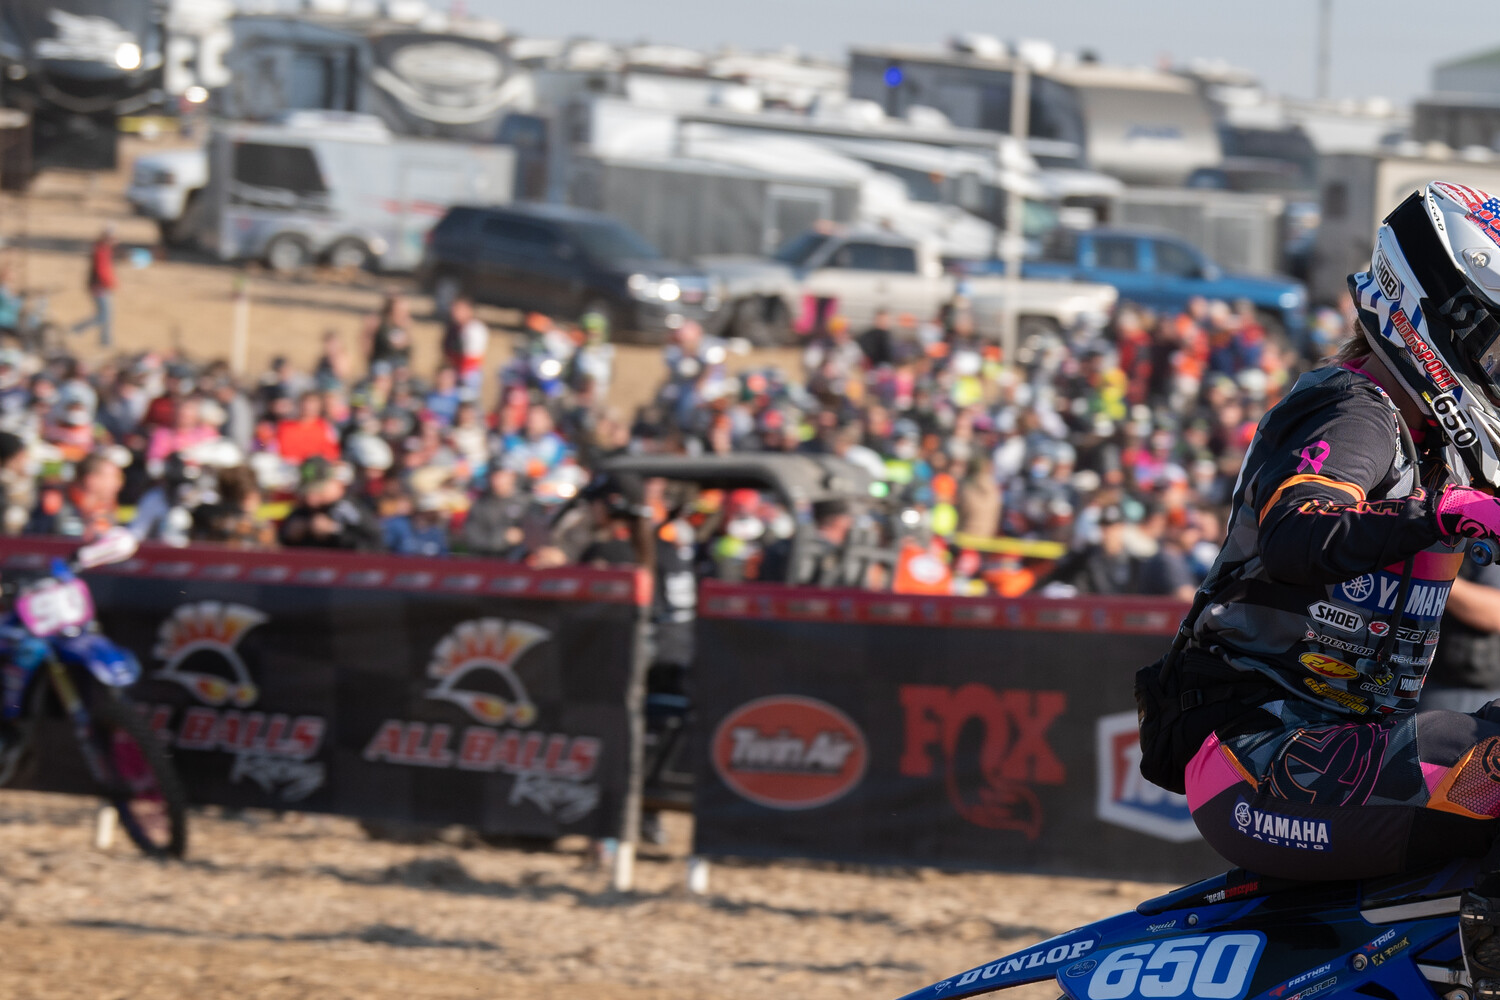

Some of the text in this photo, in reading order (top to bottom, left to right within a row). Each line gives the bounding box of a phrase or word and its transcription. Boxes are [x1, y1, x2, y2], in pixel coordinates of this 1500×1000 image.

[1374, 254, 1398, 297] SHOEI
[1435, 395, 1478, 447] 650
[1315, 604, 1360, 630] SHOEI
[1301, 653, 1359, 678] FMF
[1318, 634, 1376, 657] DUNLOP
[178, 711, 327, 759] BALLS
[364, 721, 602, 780] ALL BALLS
[730, 726, 854, 769] Twin Air
[899, 683, 1067, 815] FOX
[1238, 826, 1324, 850] RACING
[1254, 811, 1329, 844] YAMAHA
[1363, 929, 1396, 952] XTRIG
[955, 939, 1095, 987] DUNLOP
[1087, 933, 1262, 1000] 650
[1288, 963, 1331, 988] FASTWAY
